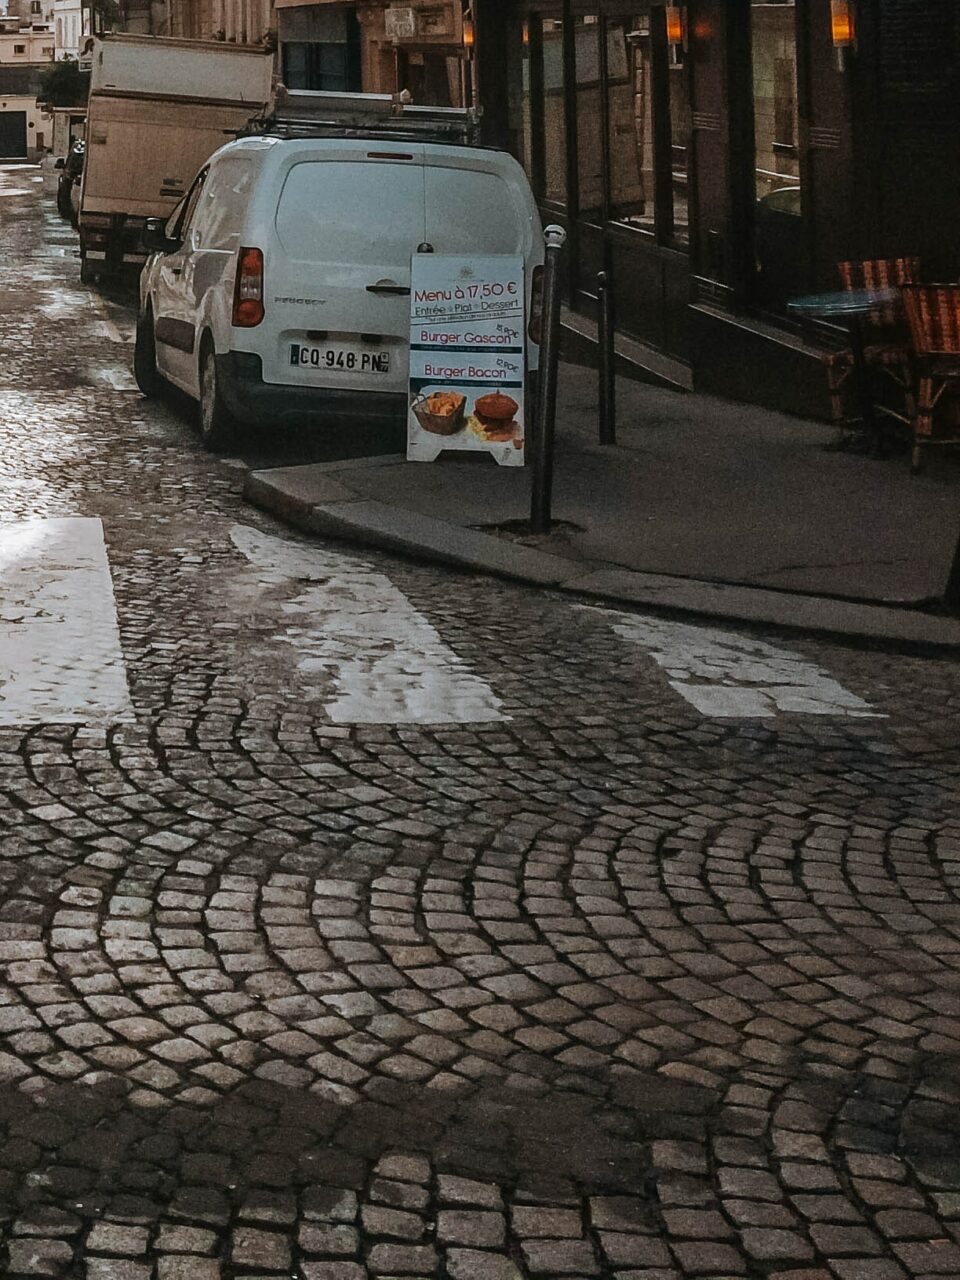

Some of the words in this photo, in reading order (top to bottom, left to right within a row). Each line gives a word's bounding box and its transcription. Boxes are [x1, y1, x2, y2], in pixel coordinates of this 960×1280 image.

[414, 289, 452, 302] Menu
[455, 285, 465, 299] à
[467, 283, 504, 299] 17,50
[507, 282, 517, 295] €
[415, 304, 446, 316] Entrée
[454, 303, 473, 313] Plat
[481, 299, 518, 311] Dessert
[420, 330, 461, 345] Burger
[464, 332, 511, 344] Gascon
[424, 364, 466, 379] Burger
[468, 366, 507, 378] Bacon
